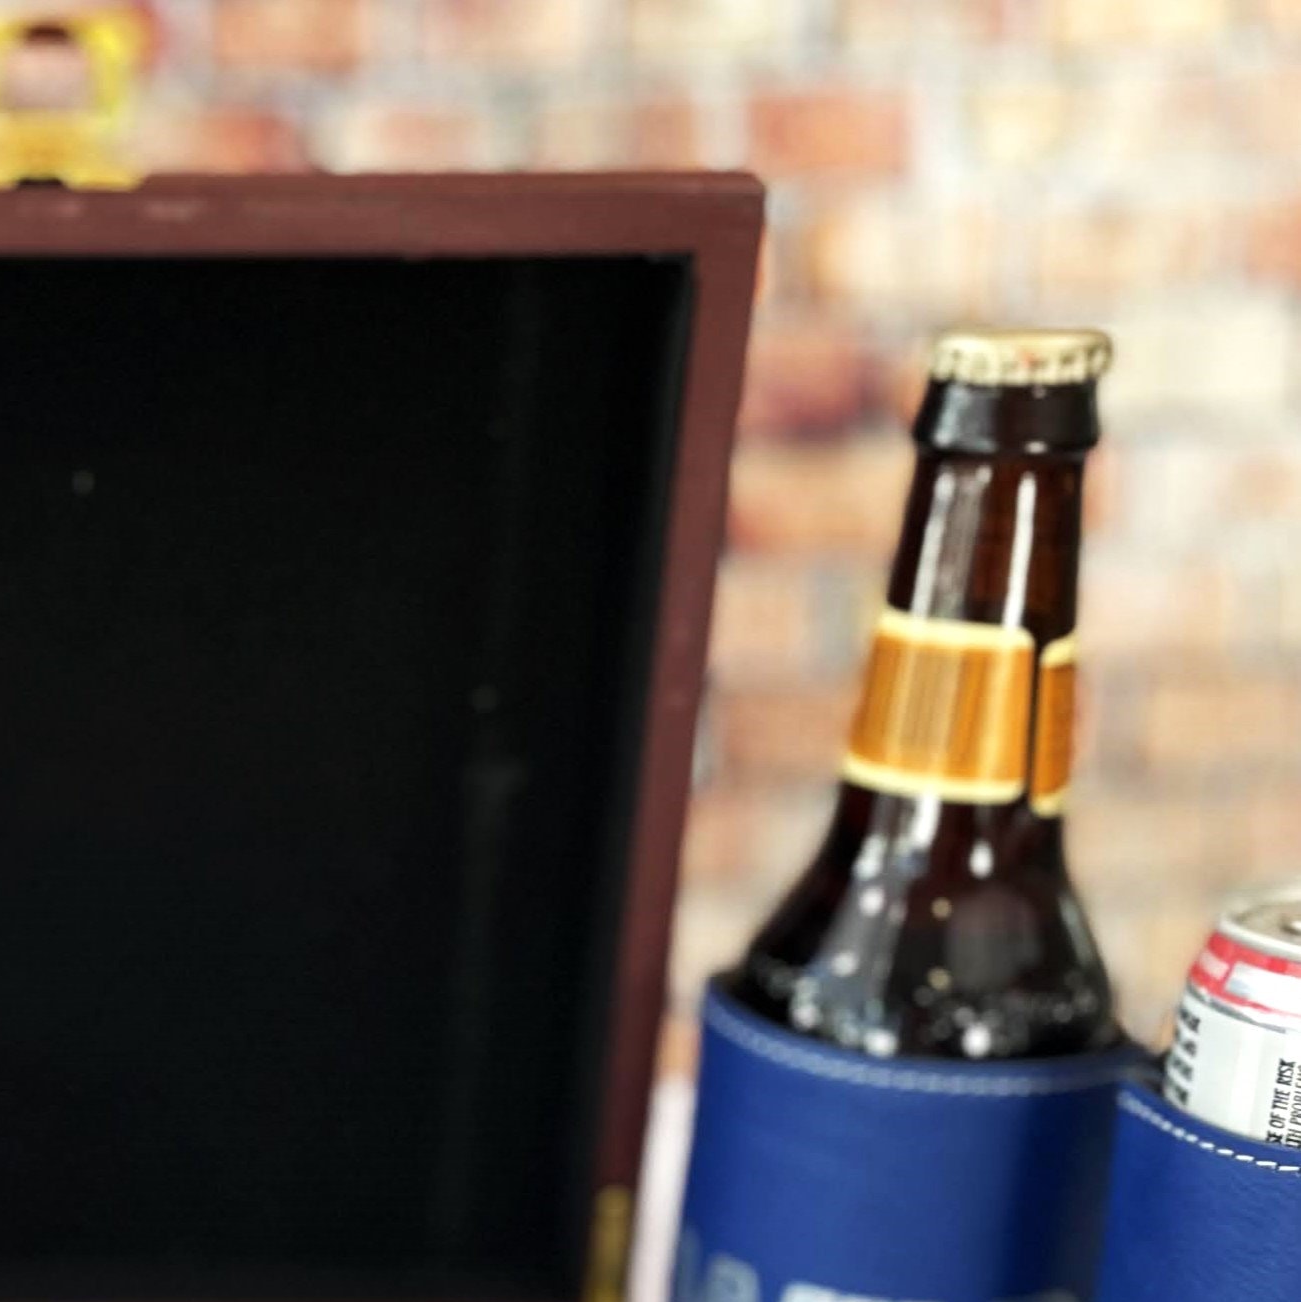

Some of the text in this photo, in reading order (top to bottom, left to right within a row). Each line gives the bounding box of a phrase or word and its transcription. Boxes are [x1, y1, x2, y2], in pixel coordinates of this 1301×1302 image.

[1276, 1057, 1296, 1086] RISK
[1271, 1087, 1291, 1110] THE
[1268, 1111, 1286, 1129] OF
